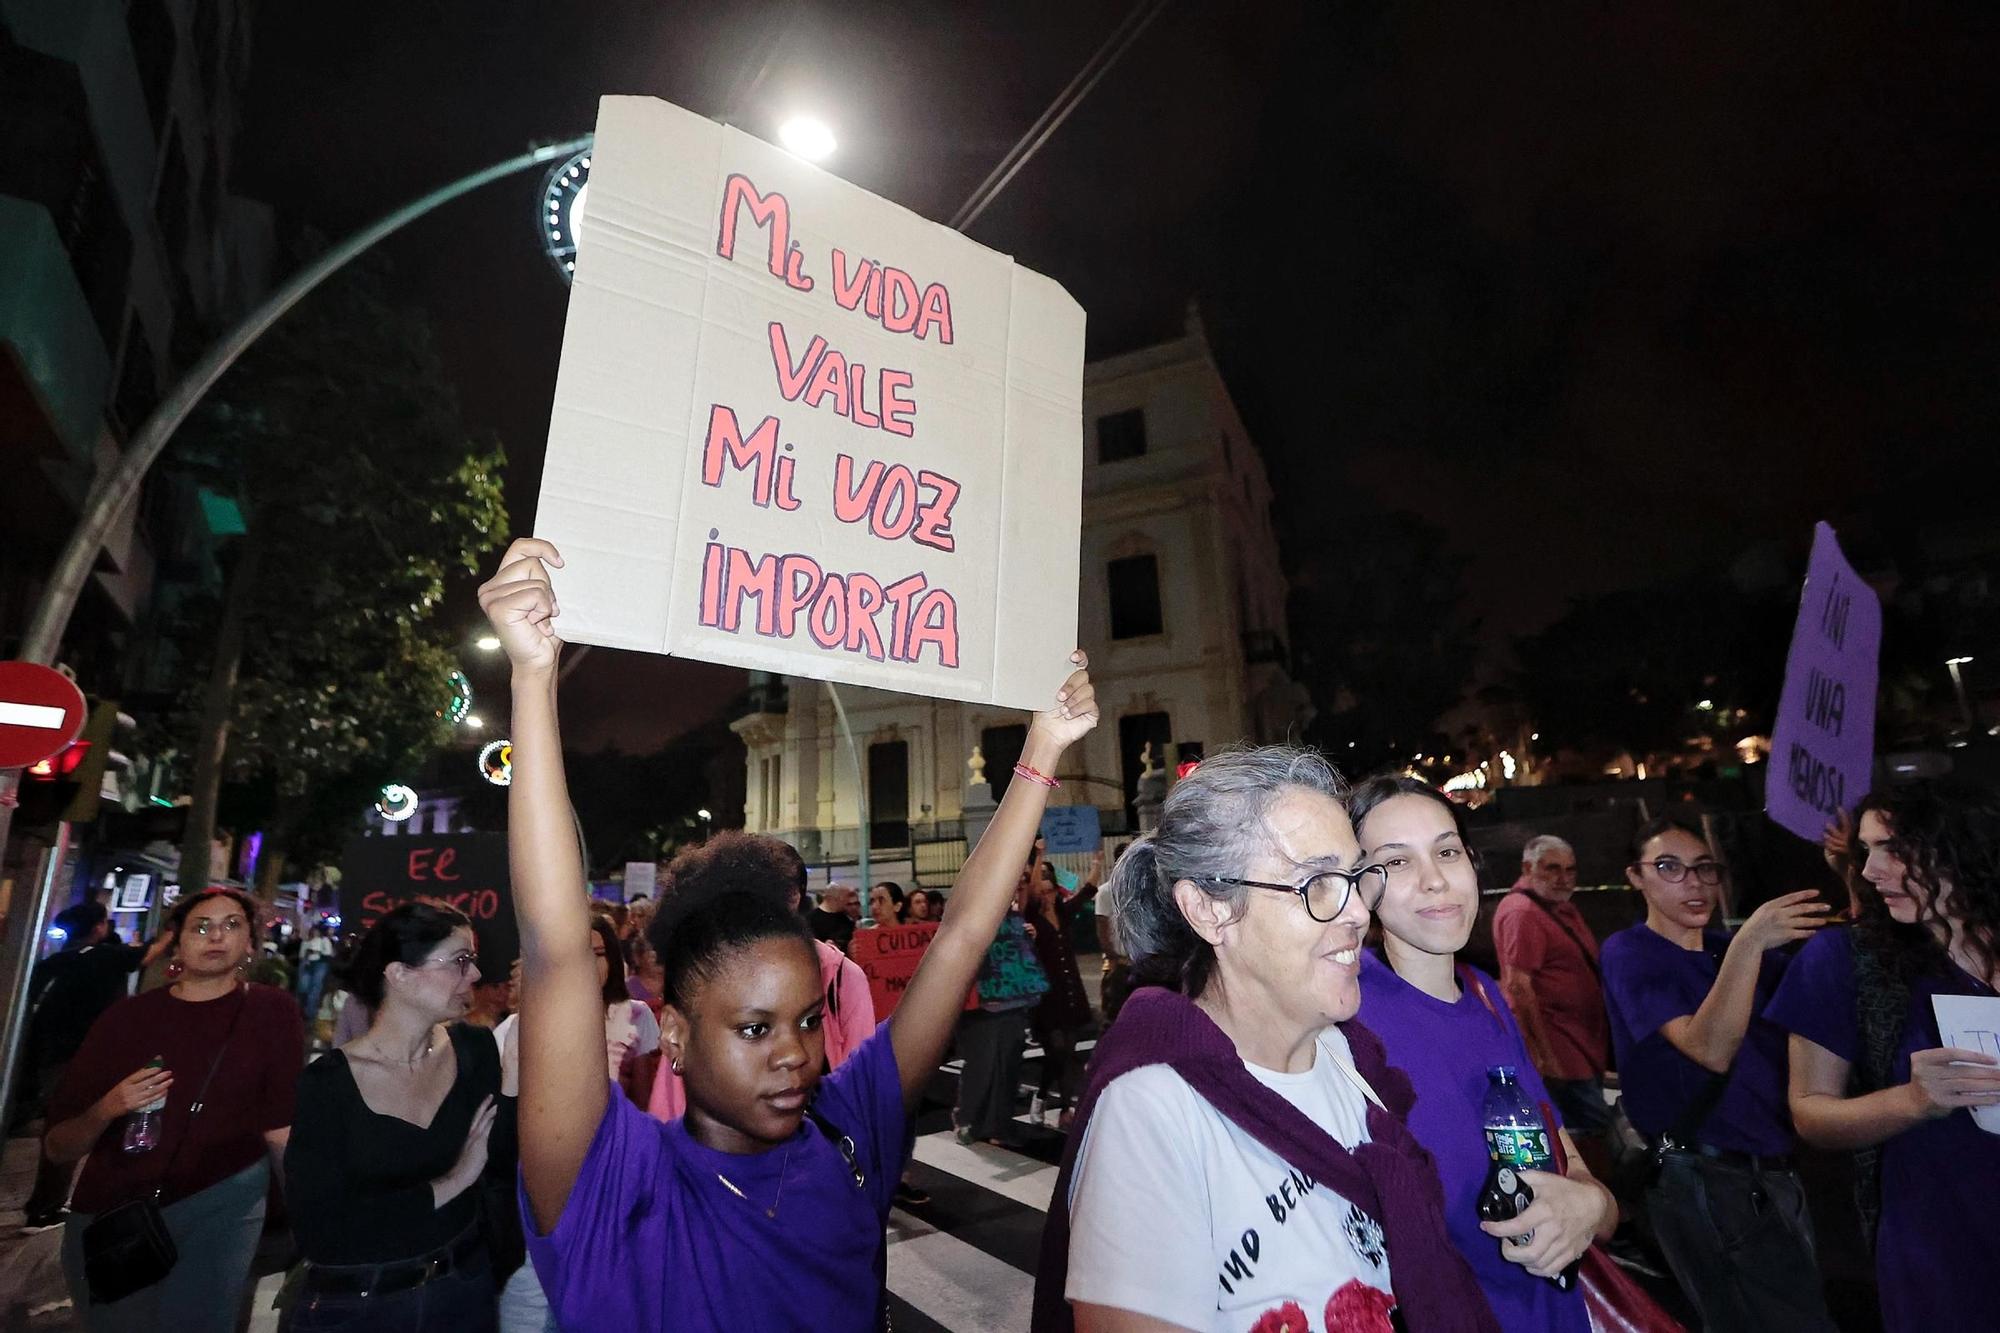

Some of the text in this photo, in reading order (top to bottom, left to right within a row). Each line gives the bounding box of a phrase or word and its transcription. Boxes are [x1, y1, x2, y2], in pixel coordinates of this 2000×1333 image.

[716, 173, 814, 291] Mi
[768, 322, 916, 438] VALE
[701, 404, 962, 552] Mi VOZ
[1804, 665, 1846, 737] UNA
[876, 928, 937, 954] CUIDA
[1218, 1228, 1260, 1295] IND
